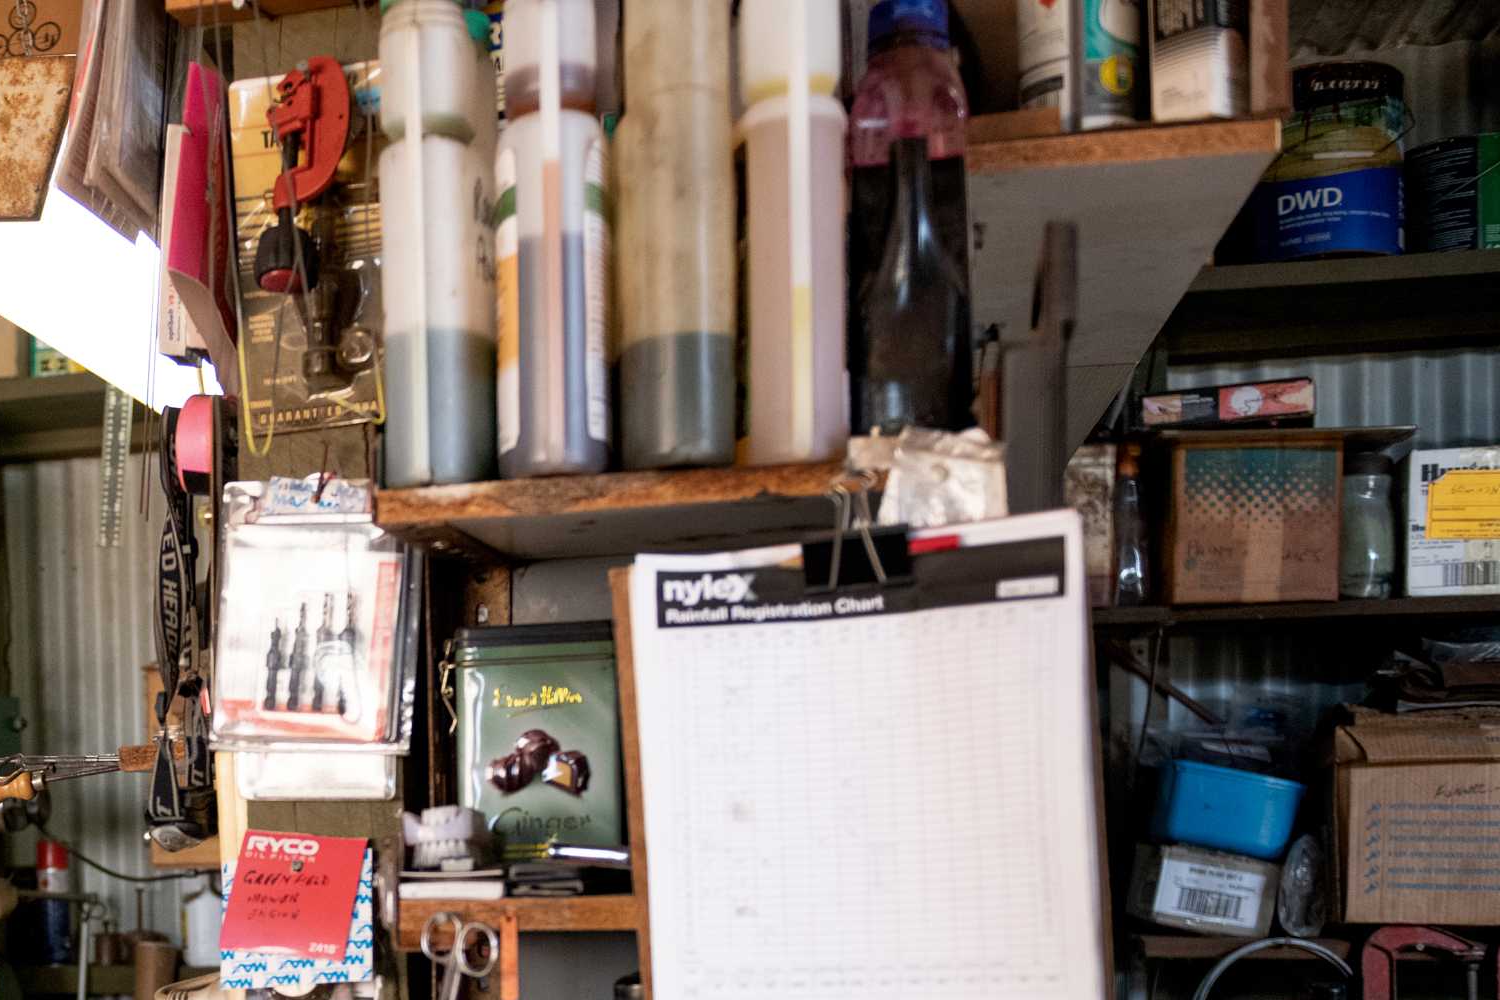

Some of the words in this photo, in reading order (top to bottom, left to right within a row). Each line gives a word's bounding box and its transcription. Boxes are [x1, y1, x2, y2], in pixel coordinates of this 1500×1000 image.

[1277, 187, 1342, 216] DWD
[661, 573, 758, 607] nylex
[665, 606, 728, 624] Rainfall
[731, 601, 832, 622] Registration
[834, 595, 884, 614] Chart
[246, 835, 320, 856] RYCO
